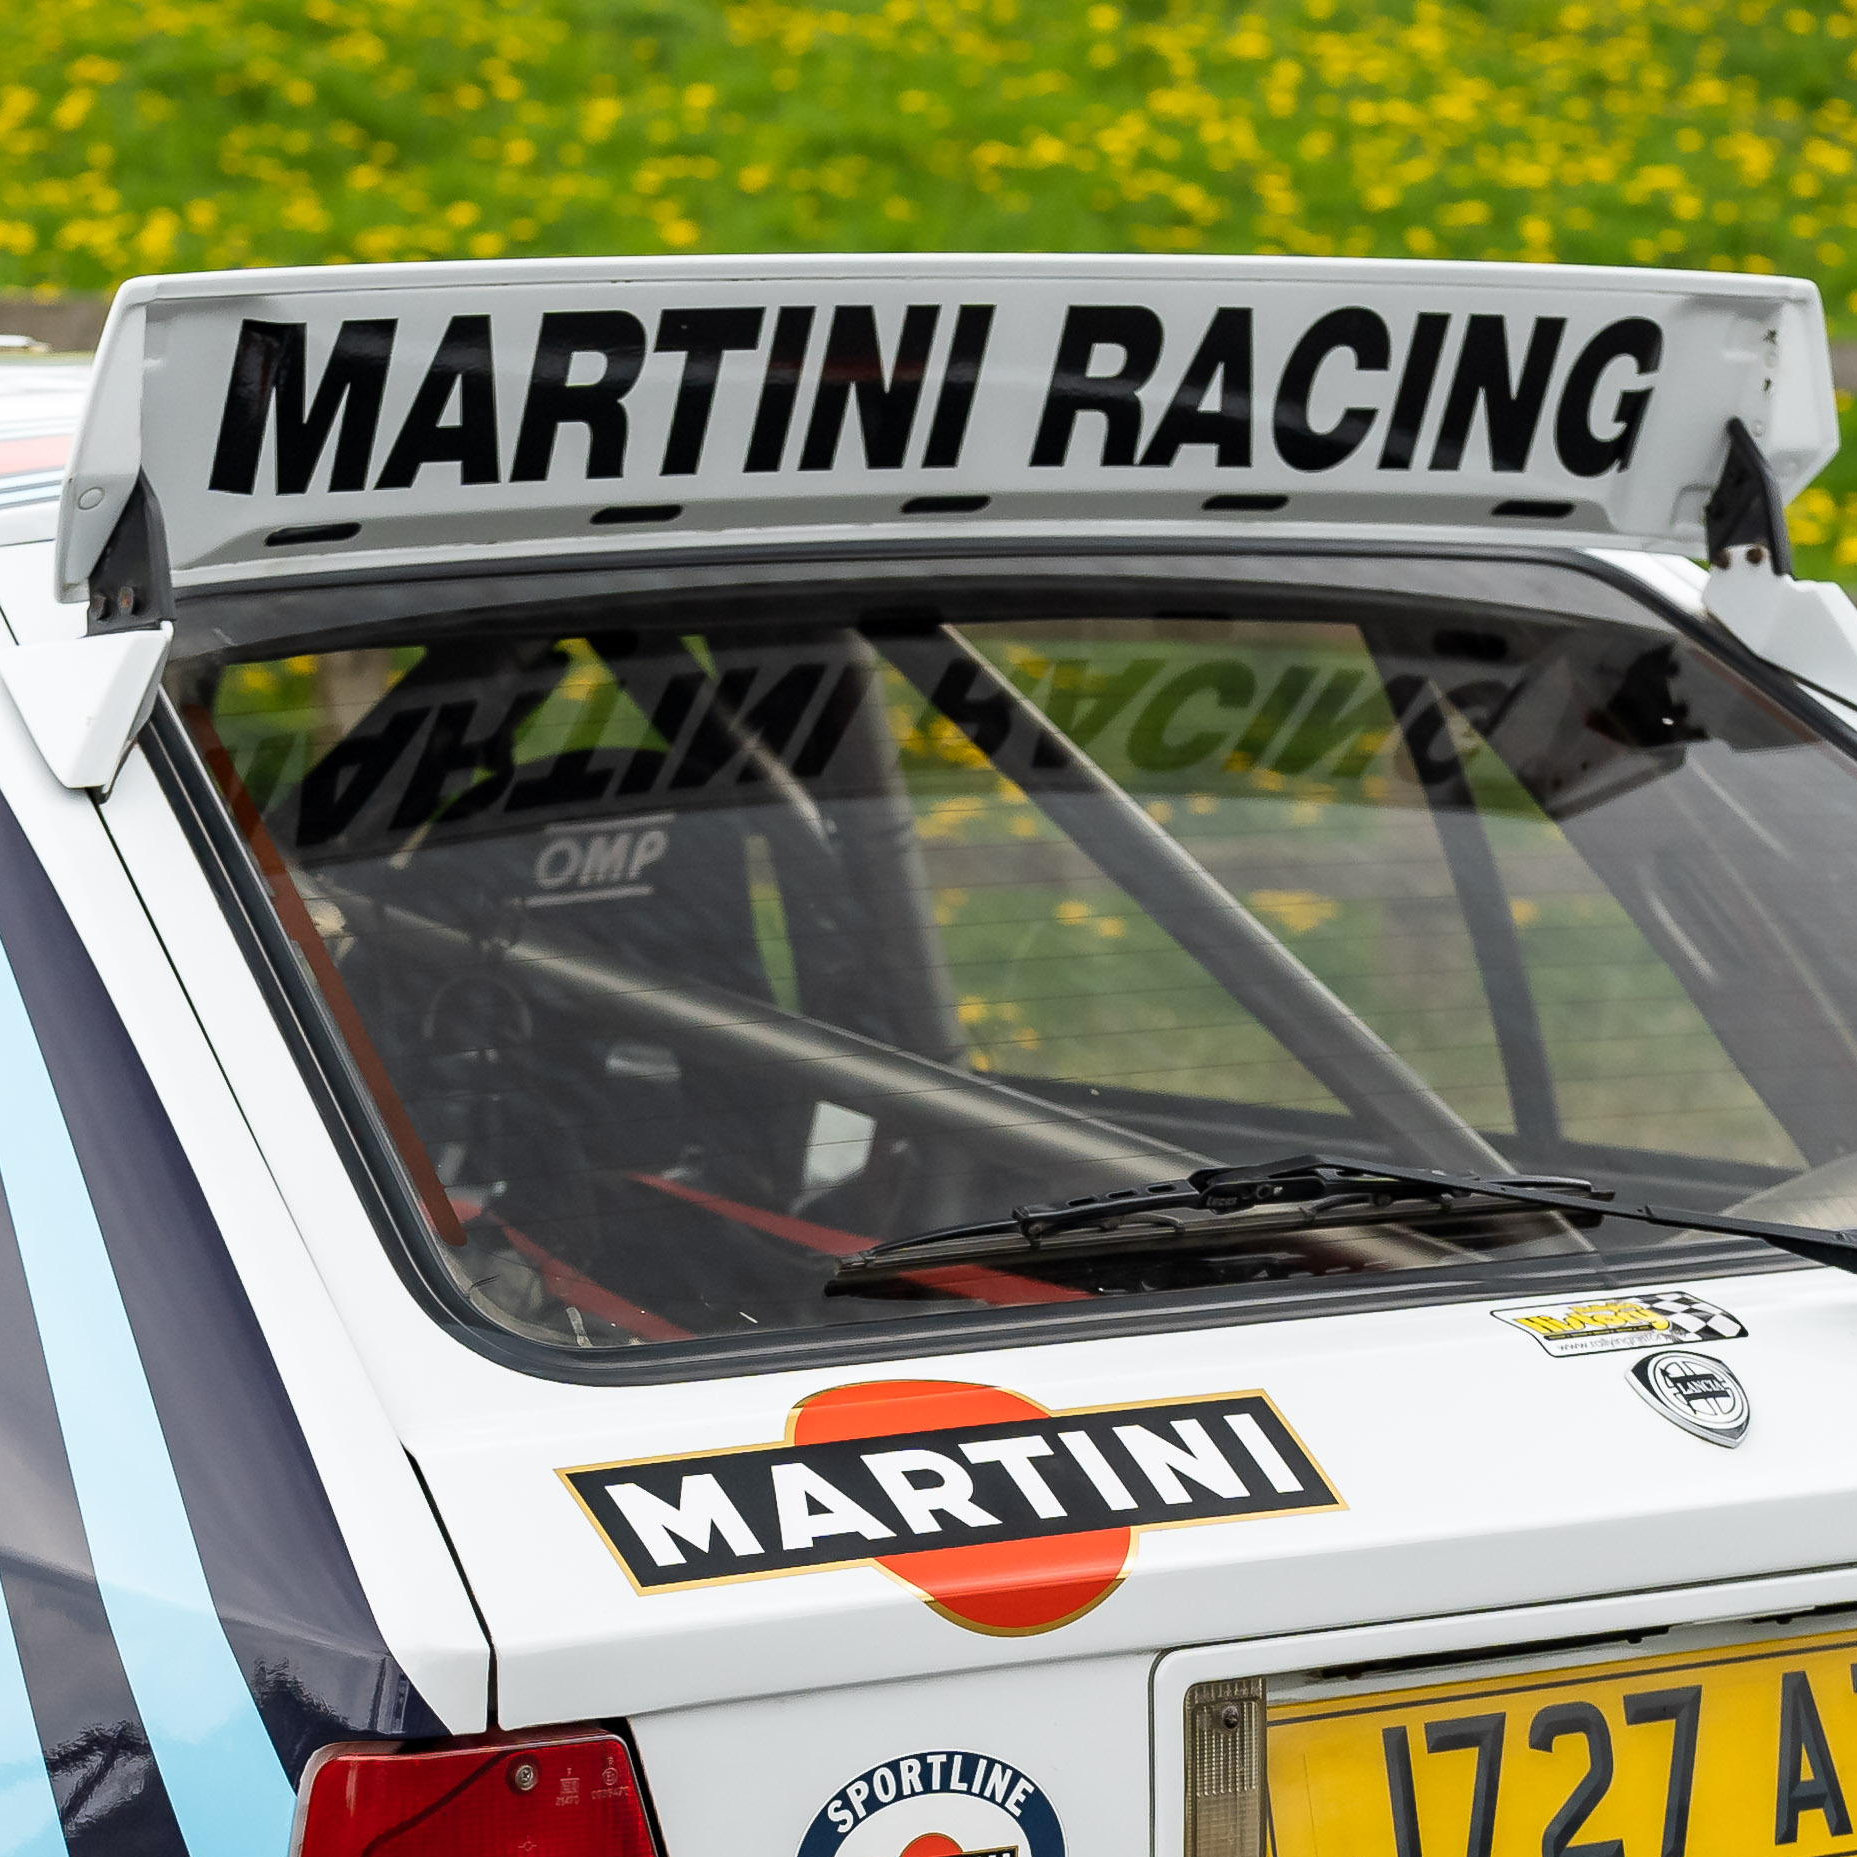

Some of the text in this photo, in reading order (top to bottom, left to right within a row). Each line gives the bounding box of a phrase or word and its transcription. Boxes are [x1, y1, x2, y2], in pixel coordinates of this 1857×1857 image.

[207, 304, 1663, 496] MARTINI RACING
[534, 829, 670, 889] OMP
[1675, 1378, 1726, 1395] LANCIA
[604, 1413, 1305, 1567] MARTINI
[827, 1753, 1035, 1834] SPORTLINE
